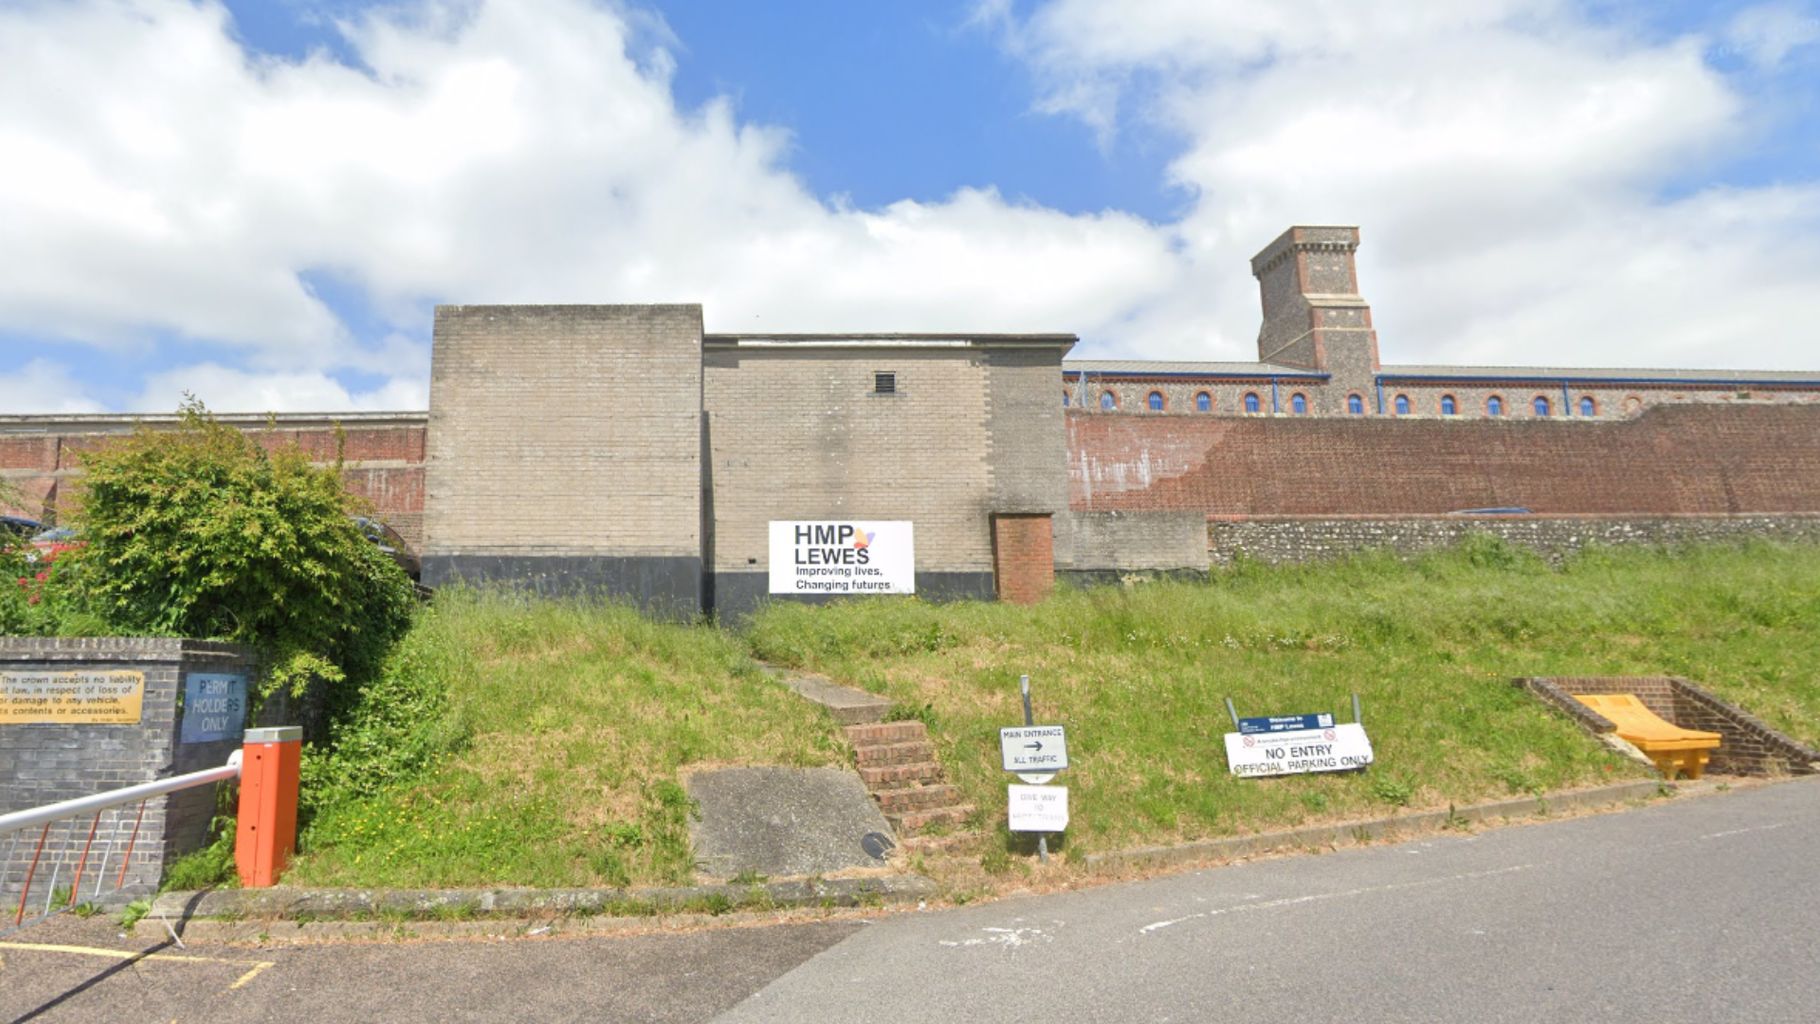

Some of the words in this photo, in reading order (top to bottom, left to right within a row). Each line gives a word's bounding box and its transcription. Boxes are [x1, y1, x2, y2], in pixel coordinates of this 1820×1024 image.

[795, 525, 854, 545] HMP
[795, 547, 870, 565] LEWES
[796, 566, 851, 577] Improving
[855, 566, 883, 577] lives,
[796, 579, 849, 590] Changing
[852, 579, 890, 590] futures
[2, 676, 17, 684] The
[52, 676, 89, 685] accepts
[109, 675, 141, 685] liability
[46, 686, 80, 696] respect
[85, 686, 94, 694] of
[98, 686, 118, 694] loss
[121, 685, 131, 694] of
[200, 680, 237, 695] PERMIT
[12, 697, 48, 706] damage
[193, 698, 240, 713] HOLDERS
[12, 707, 52, 715] contents
[201, 716, 230, 731] ONLY
[1003, 730, 1022, 738] MAIN
[1024, 728, 1062, 737] ENTRANCE
[1265, 747, 1285, 759] NO
[1290, 744, 1333, 758] ENTRY
[1029, 754, 1057, 764] TRAFFIC
[1233, 762, 1284, 775] OFFICIAL
[1287, 757, 1337, 770] PARKING
[1341, 754, 1369, 766] ONLY
